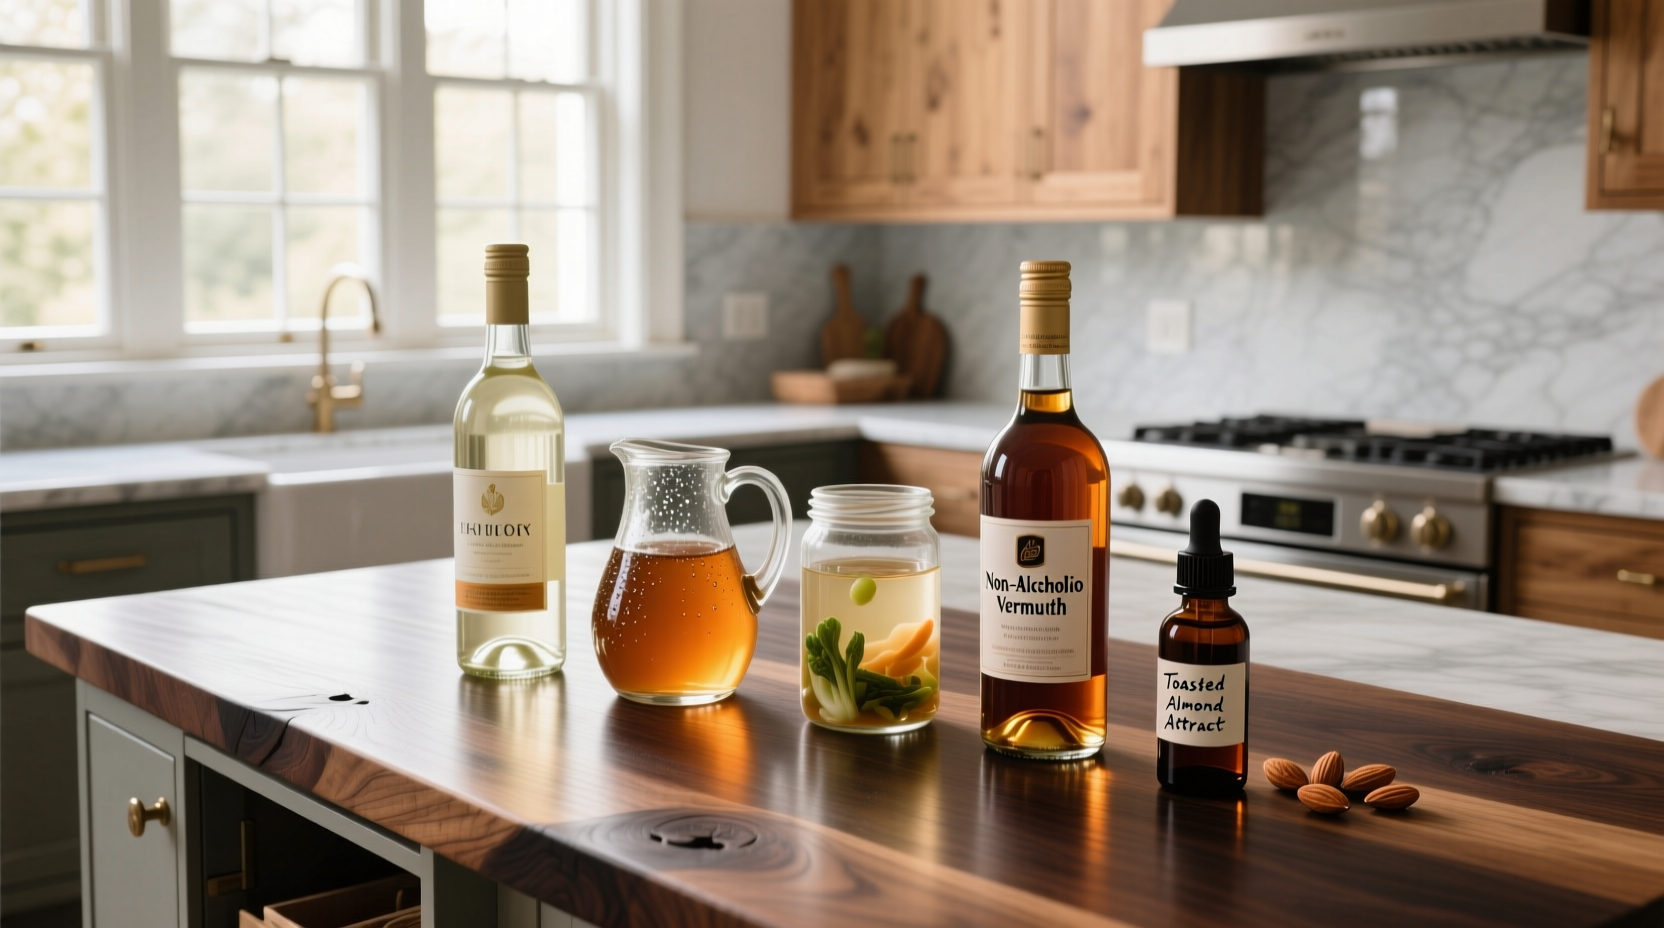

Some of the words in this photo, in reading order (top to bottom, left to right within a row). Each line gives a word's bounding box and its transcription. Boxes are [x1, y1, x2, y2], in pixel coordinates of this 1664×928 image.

[1163, 672, 1226, 692] Toasted
[1165, 695, 1224, 713] Almond
[1164, 713, 1226, 733] Attract
